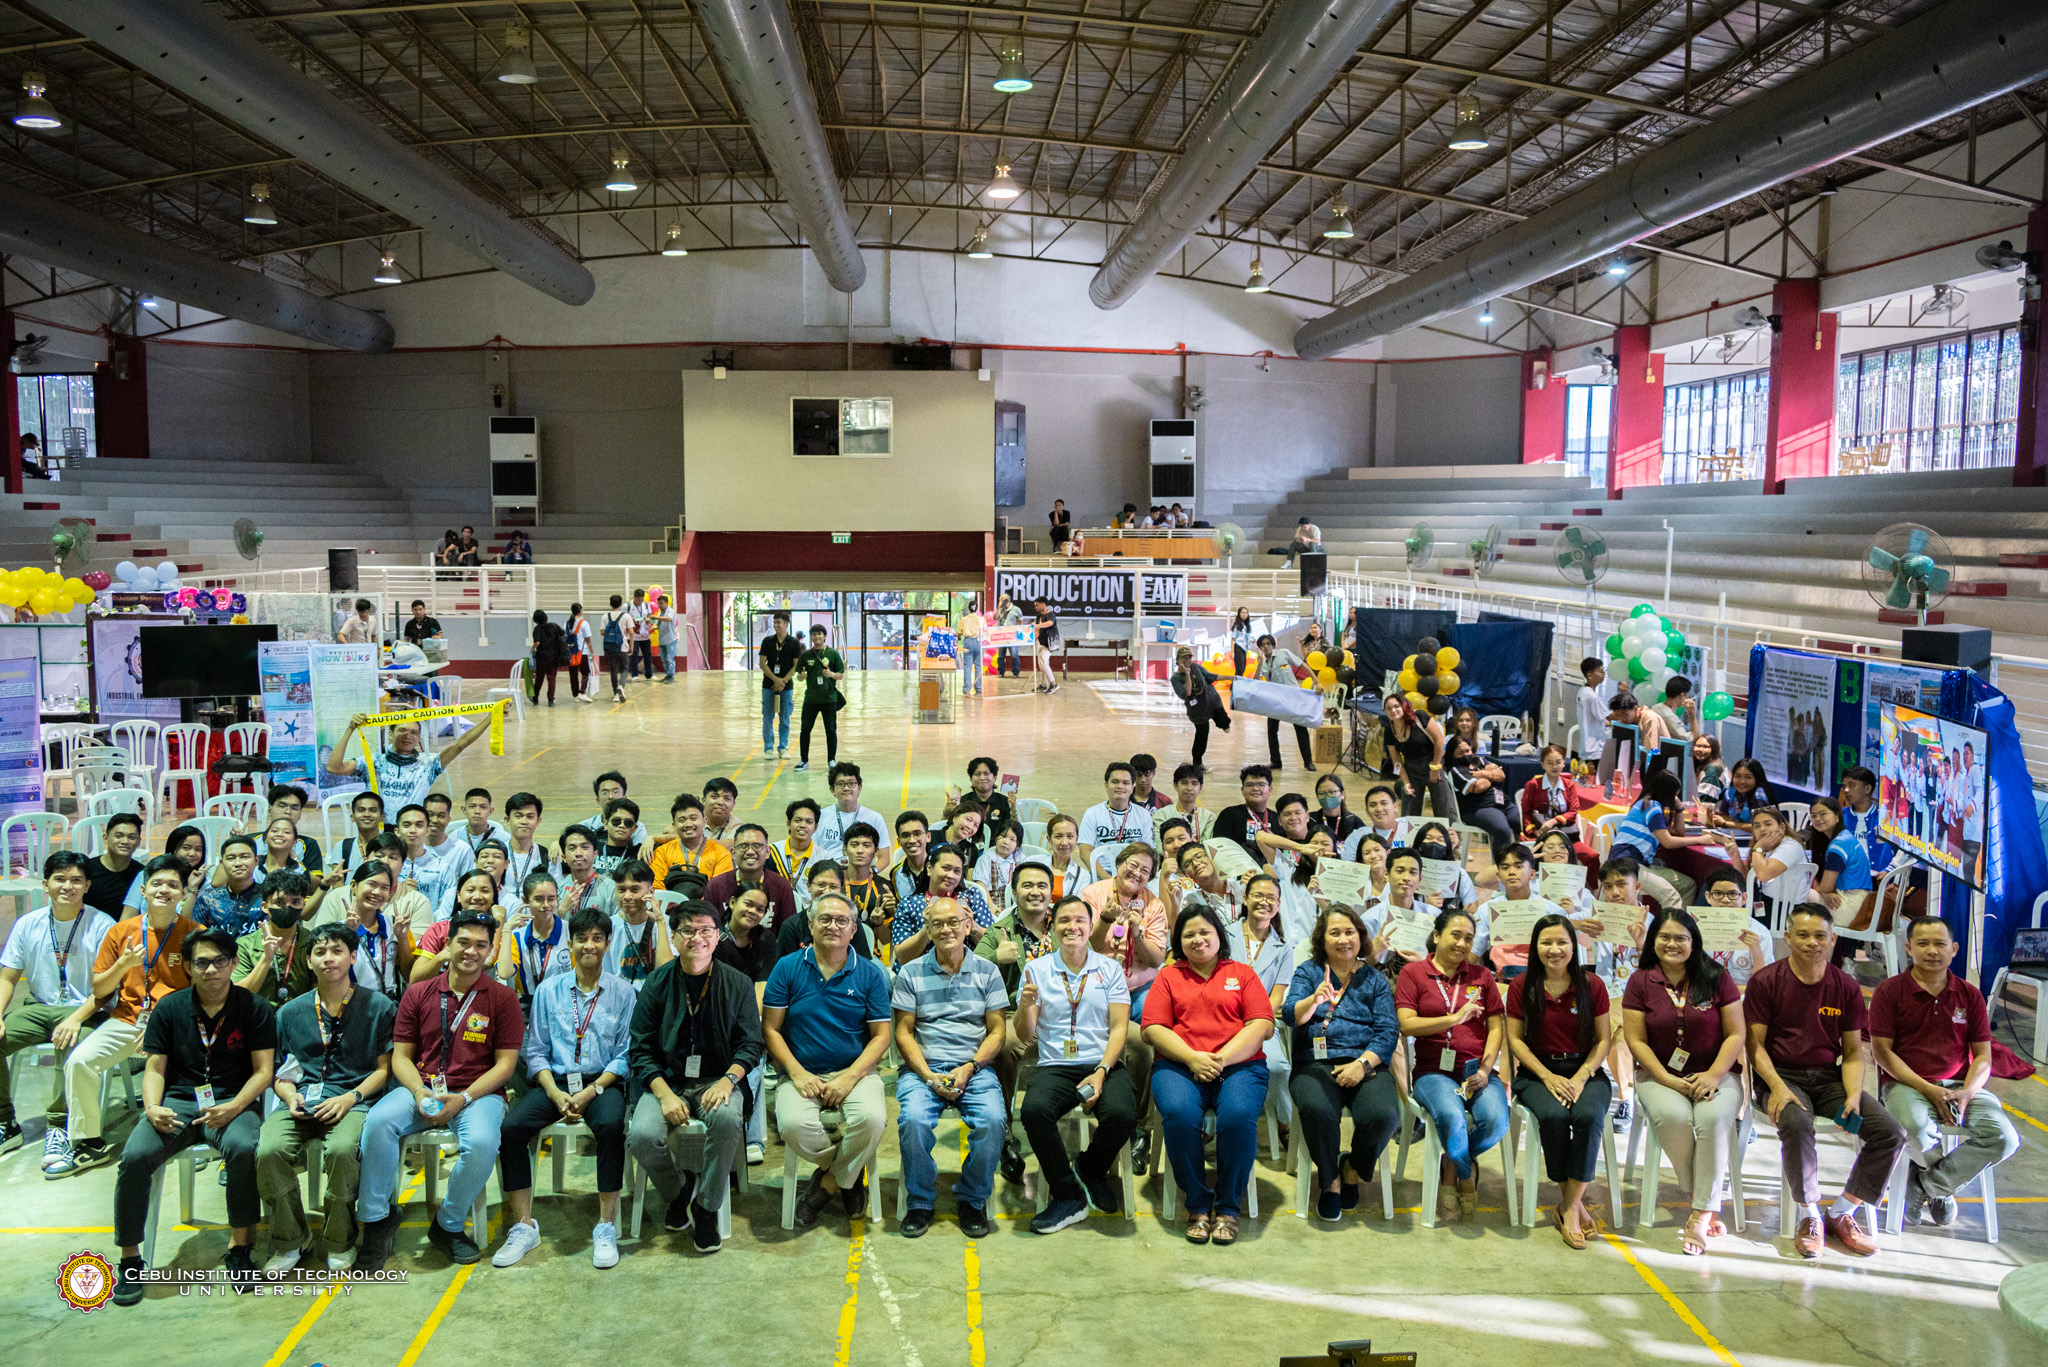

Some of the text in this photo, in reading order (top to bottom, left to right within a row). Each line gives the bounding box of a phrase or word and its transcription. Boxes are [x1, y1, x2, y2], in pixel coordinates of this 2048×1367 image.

[1000, 574, 1183, 604] PRODUCTION TEAM
[106, 692, 135, 700] INDUSTRIAL
[413, 708, 455, 719] CAUTION
[460, 703, 495, 713] CAUTIO
[365, 713, 408, 725] CAUTION
[1096, 825, 1143, 844] Dodgers
[1880, 819, 1960, 868] Cake Decorating Champion
[570, 989, 580, 1029] WILDCATS
